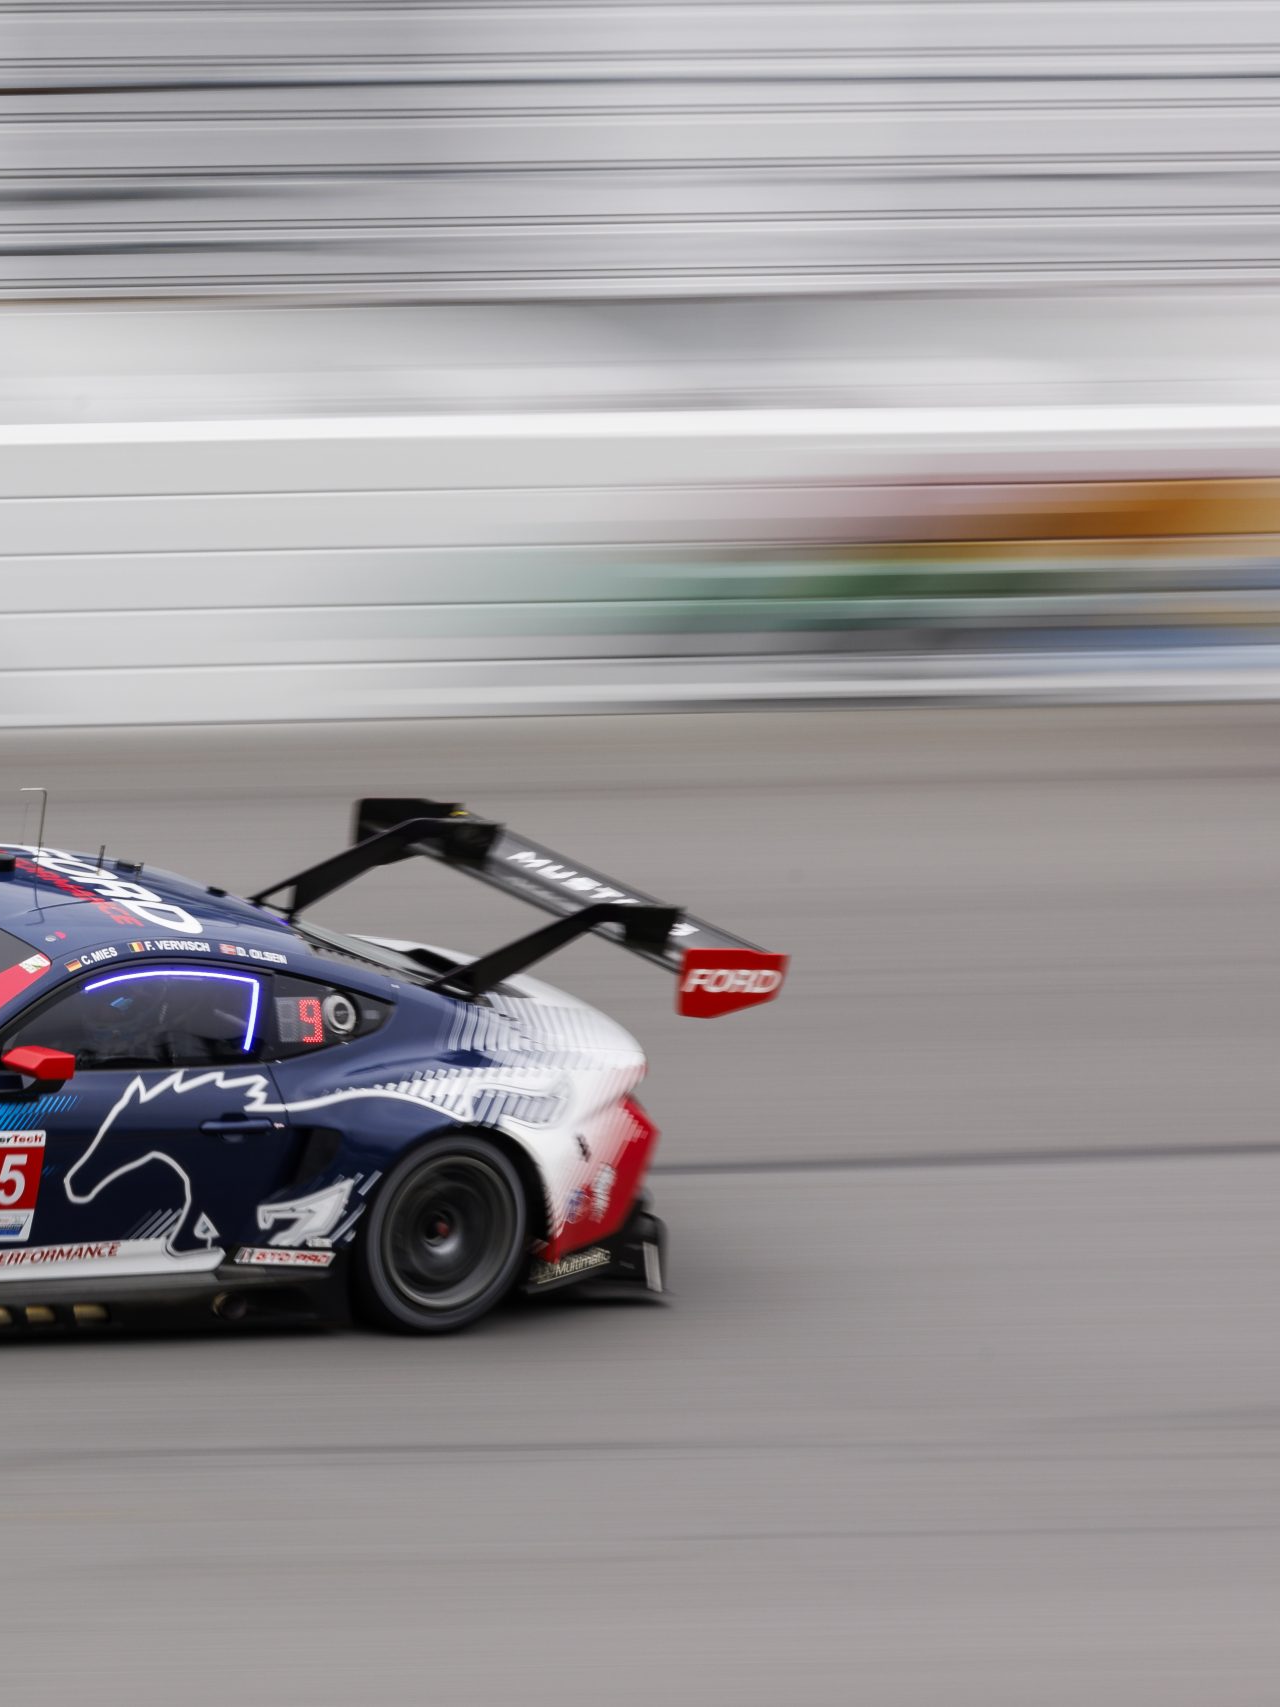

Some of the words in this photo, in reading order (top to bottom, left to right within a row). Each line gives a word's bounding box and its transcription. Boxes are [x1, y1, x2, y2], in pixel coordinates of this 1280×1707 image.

[80, 955, 94, 966] C.
[91, 946, 118, 963] MIES
[143, 941, 156, 951] F.
[155, 940, 211, 953] VERVISCH
[248, 948, 288, 965] OLSEN
[680, 969, 783, 994] FORD
[298, 999, 323, 1043] 9
